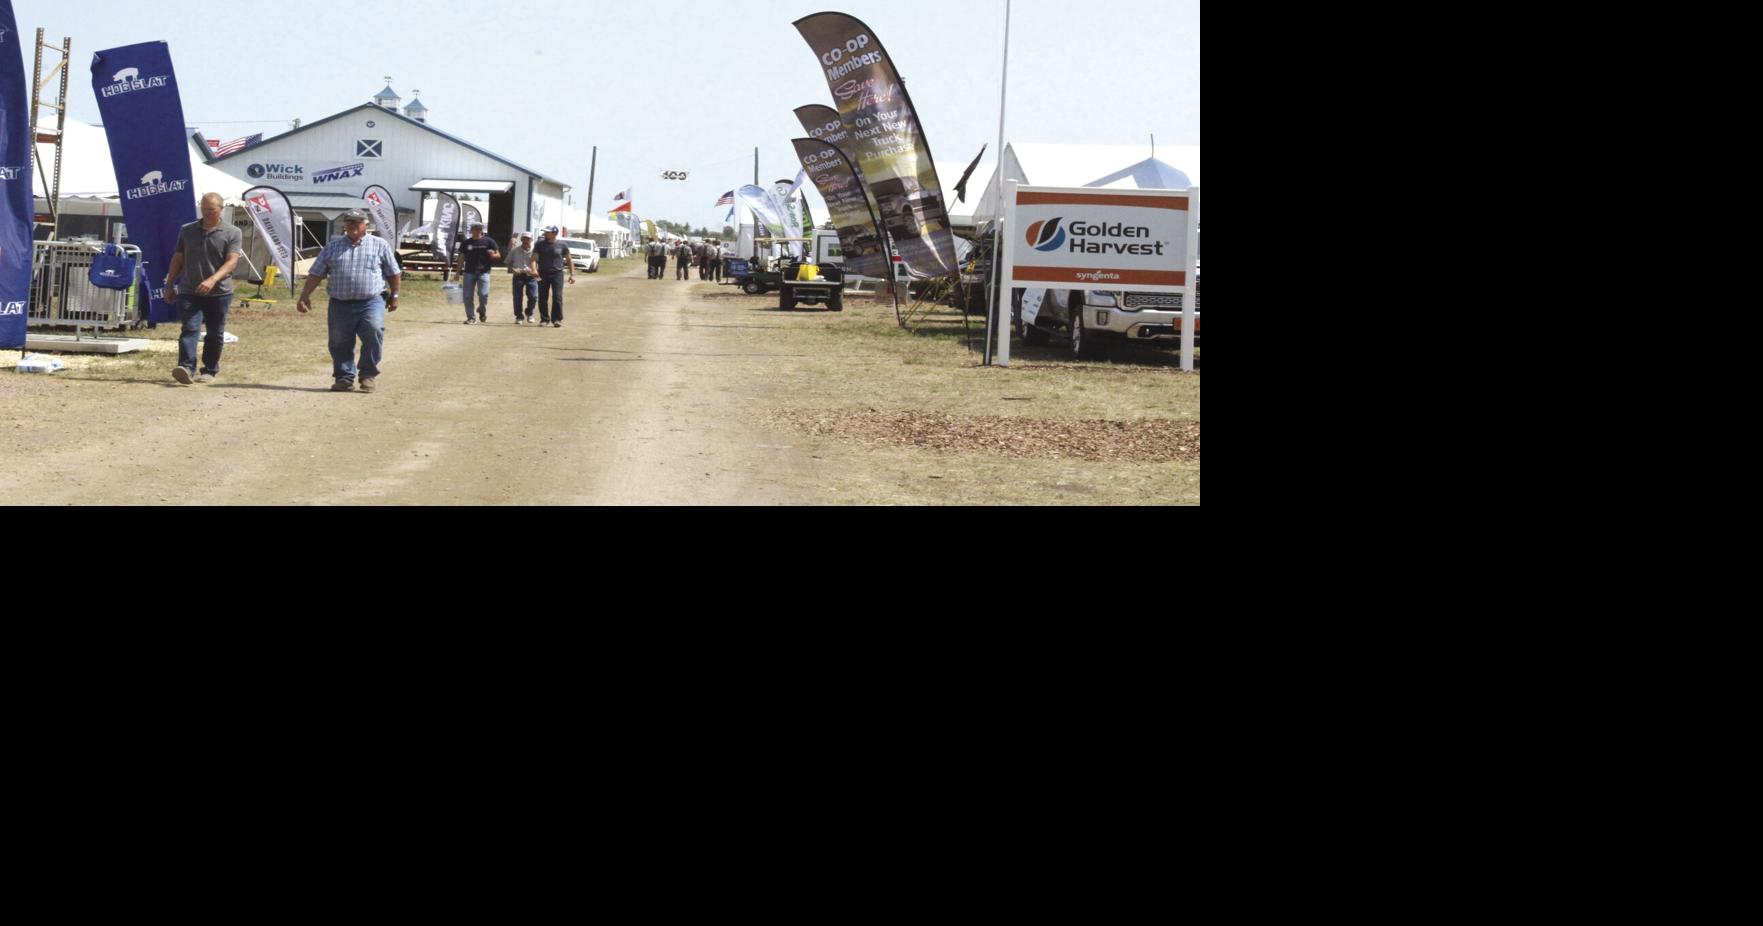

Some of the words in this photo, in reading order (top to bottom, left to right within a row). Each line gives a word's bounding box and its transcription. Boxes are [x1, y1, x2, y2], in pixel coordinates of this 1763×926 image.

[822, 34, 869, 66] CO-OP
[827, 50, 882, 81] Members
[101, 82, 131, 97] HOG
[131, 76, 168, 91] SLAT
[855, 117, 871, 127] On
[872, 110, 898, 122] Your
[809, 120, 841, 138] CO-OP
[854, 126, 881, 141] Next
[882, 120, 907, 132] New
[872, 133, 903, 147] Truck
[804, 149, 836, 164] CO-OP
[0, 166, 21, 180] AT
[265, 163, 304, 174] Wick
[312, 167, 363, 184] WNAX
[266, 173, 304, 182] Buildings
[1069, 221, 1149, 238] Golden
[1069, 238, 1164, 256] Harvest
[1076, 271, 1120, 281] syngenta
[0, 301, 25, 316] LAT
